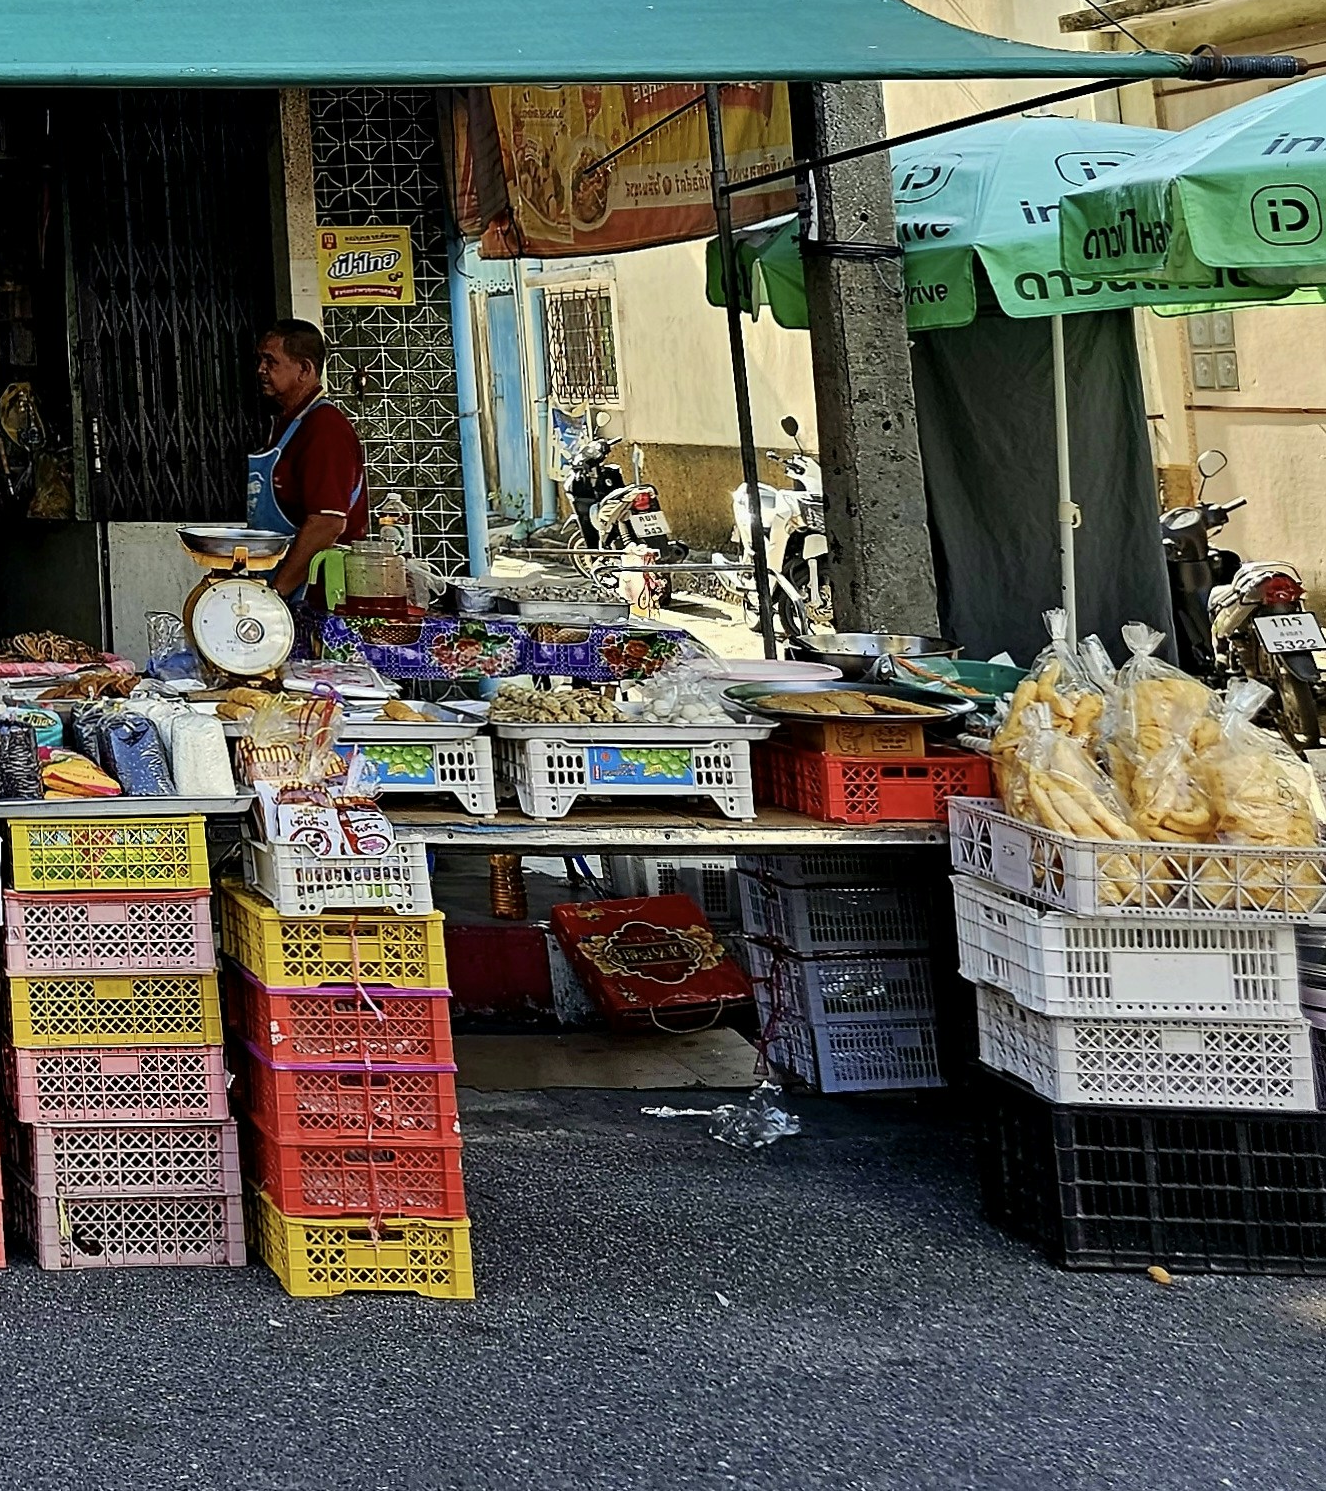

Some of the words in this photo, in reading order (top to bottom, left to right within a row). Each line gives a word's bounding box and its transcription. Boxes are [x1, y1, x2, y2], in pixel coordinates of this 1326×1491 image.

[333, 250, 398, 278] ฟ้าไทย
[1272, 638, 1319, 651] 5322
